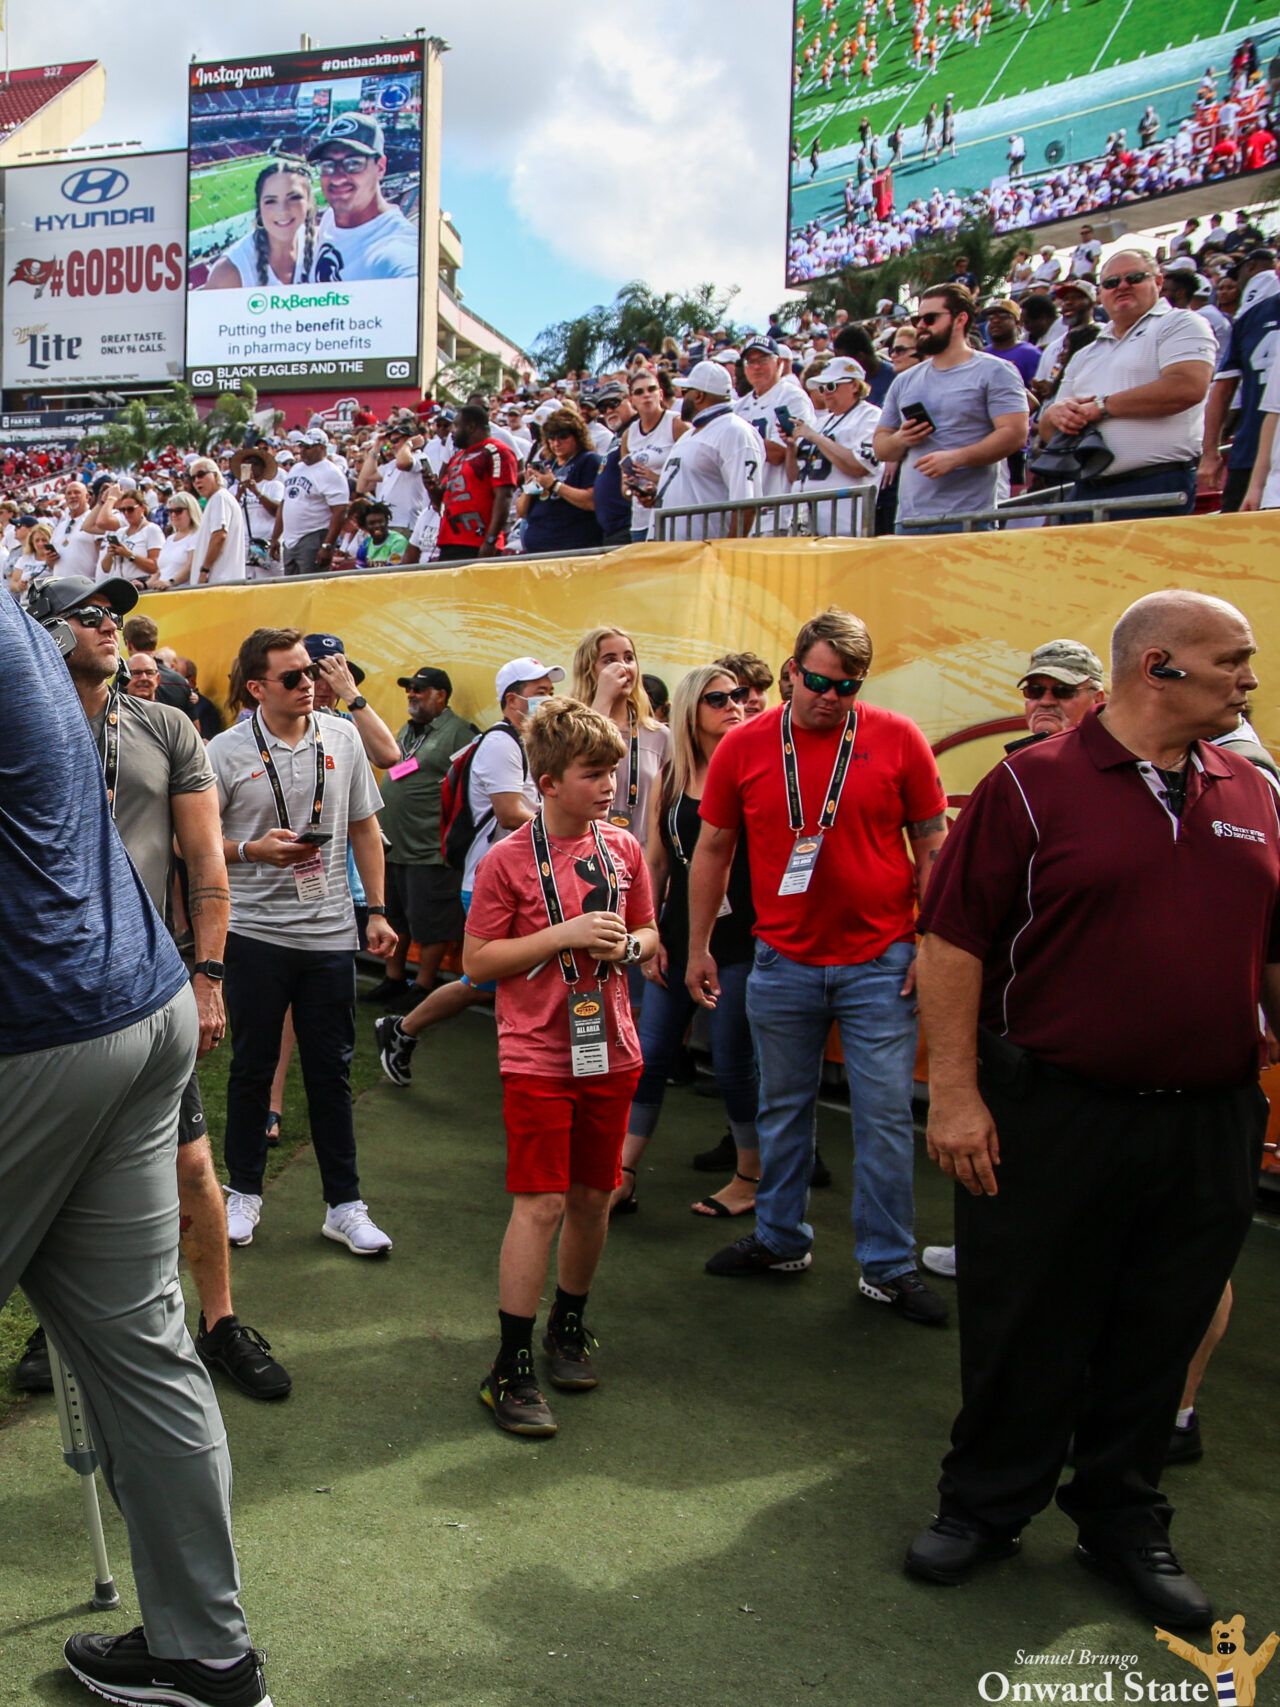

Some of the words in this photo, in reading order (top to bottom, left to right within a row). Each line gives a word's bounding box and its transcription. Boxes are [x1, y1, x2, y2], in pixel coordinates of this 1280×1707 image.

[43, 66, 63, 77] 327
[321, 51, 416, 72] #OutbackBowl
[196, 64, 275, 88] Instagram
[35, 206, 155, 232] HYUNDAI
[50, 242, 183, 298] #GOBUCS
[270, 291, 350, 312] RxBenefits
[219, 322, 267, 338] Putting
[270, 320, 292, 335] the
[296, 318, 345, 333] benefit
[349, 316, 383, 330] back
[101, 333, 132, 344] GREAT
[134, 332, 166, 342] TASTE.
[228, 342, 240, 355] in
[244, 339, 311, 357] pharmacy
[315, 335, 372, 351] benefits
[27, 334, 83, 370] Lite
[101, 345, 126, 355] ONLY
[127, 345, 137, 354] 96
[139, 343, 166, 353] CALS.
[194, 373, 212, 384] CC
[217, 364, 257, 379] BLACK
[259, 363, 308, 377] EAGLES
[310, 362, 337, 374] AND
[338, 361, 364, 373] THE
[389, 364, 408, 376] CC
[217, 378, 241, 390] THE
[745, 460, 758, 481] 7
[576, 1026, 586, 1034] ALL
[586, 1024, 600, 1033] AREA
